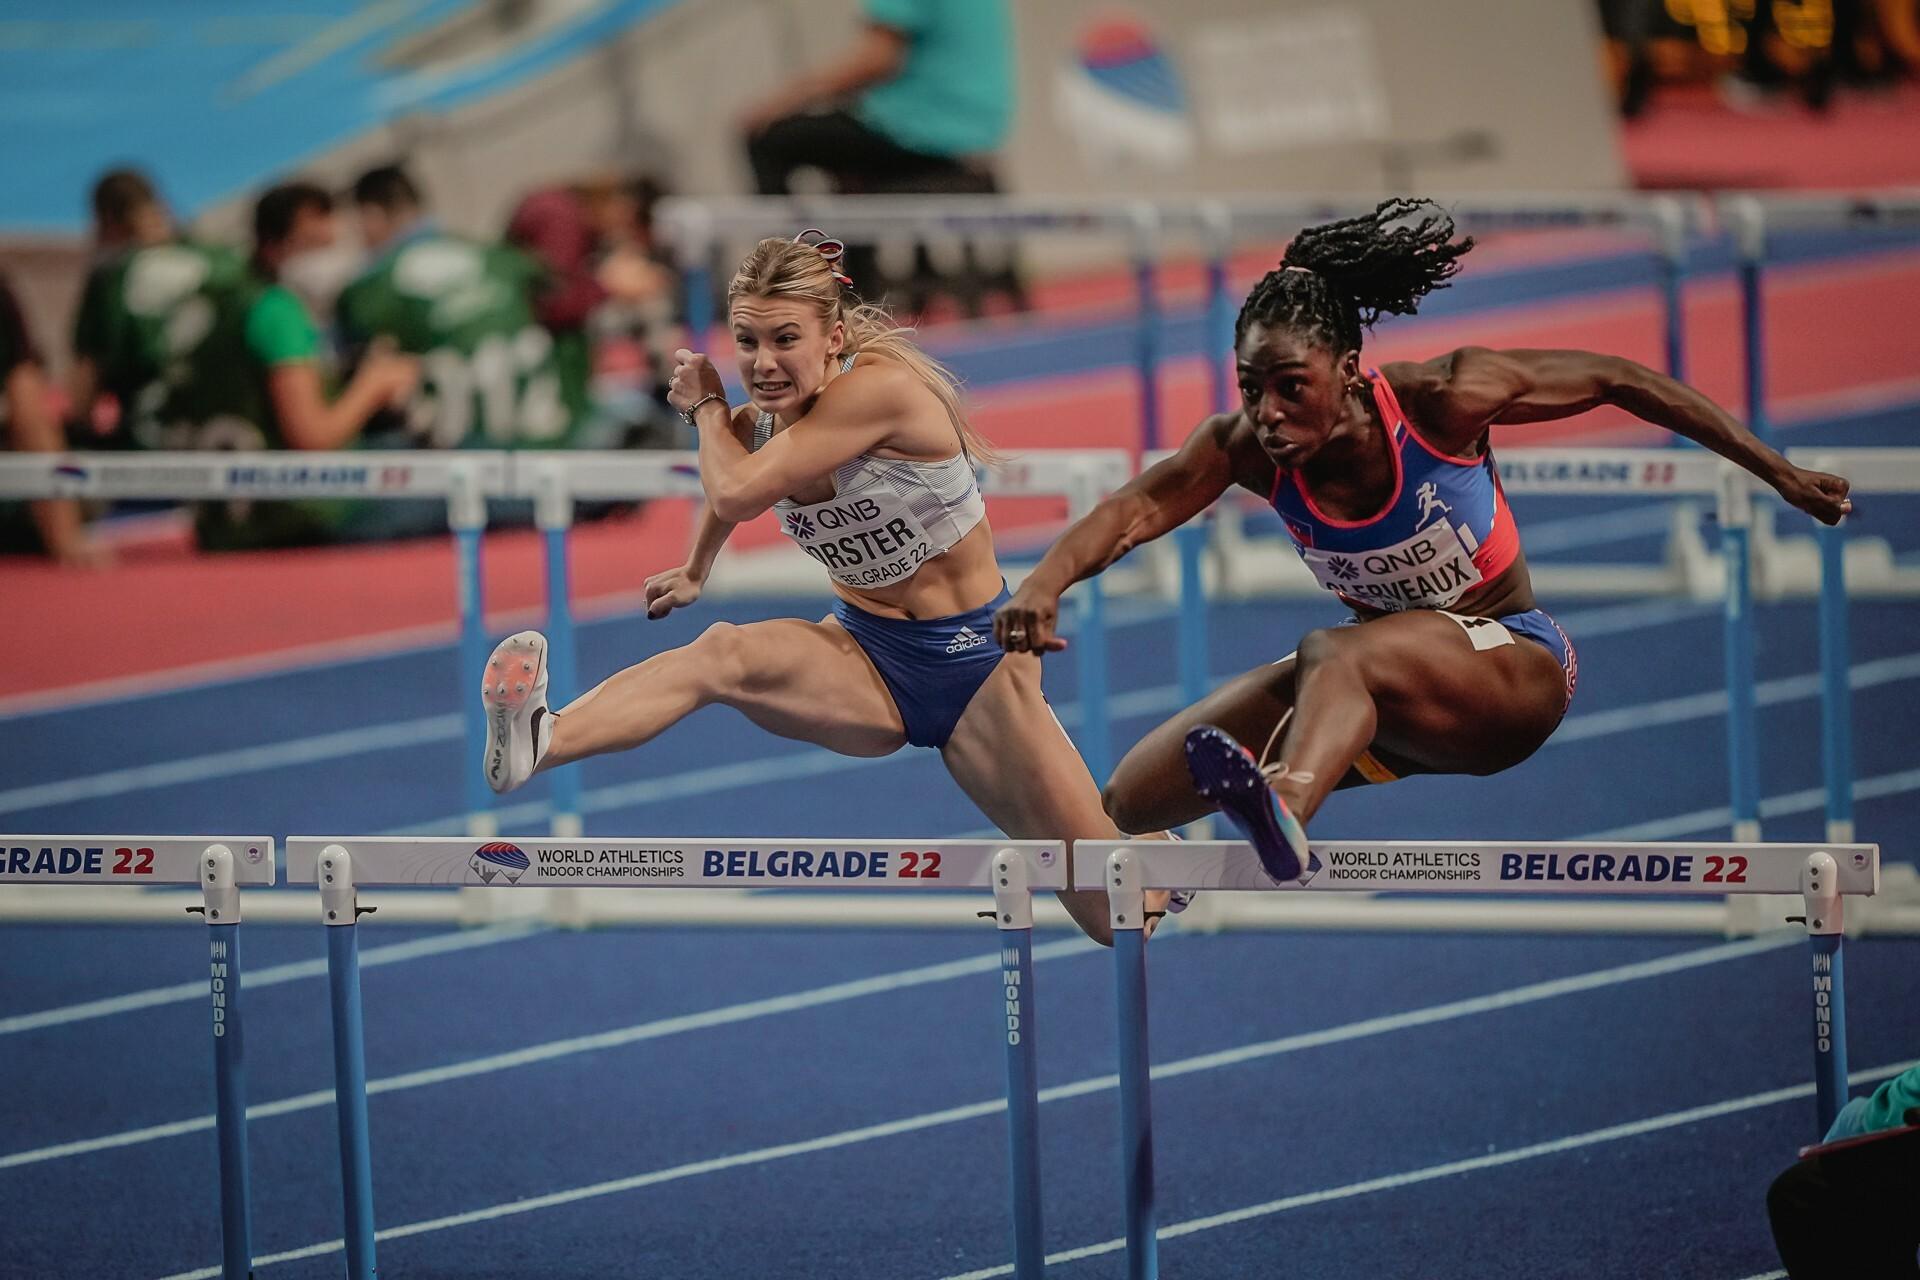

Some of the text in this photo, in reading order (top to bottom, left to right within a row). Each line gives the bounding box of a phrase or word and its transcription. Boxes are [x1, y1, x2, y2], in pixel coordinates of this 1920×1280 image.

[816, 498, 881, 529] QNB
[909, 542, 928, 564] 22
[1364, 539, 1437, 575] QNB
[945, 635, 988, 654] adidas
[112, 847, 155, 875] 22
[537, 849, 684, 864] WORLD ATHLETICS
[702, 850, 942, 878] BELGRADE 22
[1329, 852, 1481, 867] WORLD ATHLETICS
[1500, 853, 1748, 883] BELGRADE 22
[537, 866, 684, 877] INDOOR CHAMPIONSHIPS
[1329, 869, 1481, 881] INDOOR CHAMPIONSHIPS
[210, 963, 227, 1037] MONDO
[1003, 970, 1020, 1046] MONDO
[1813, 976, 1832, 1053] MONDO
